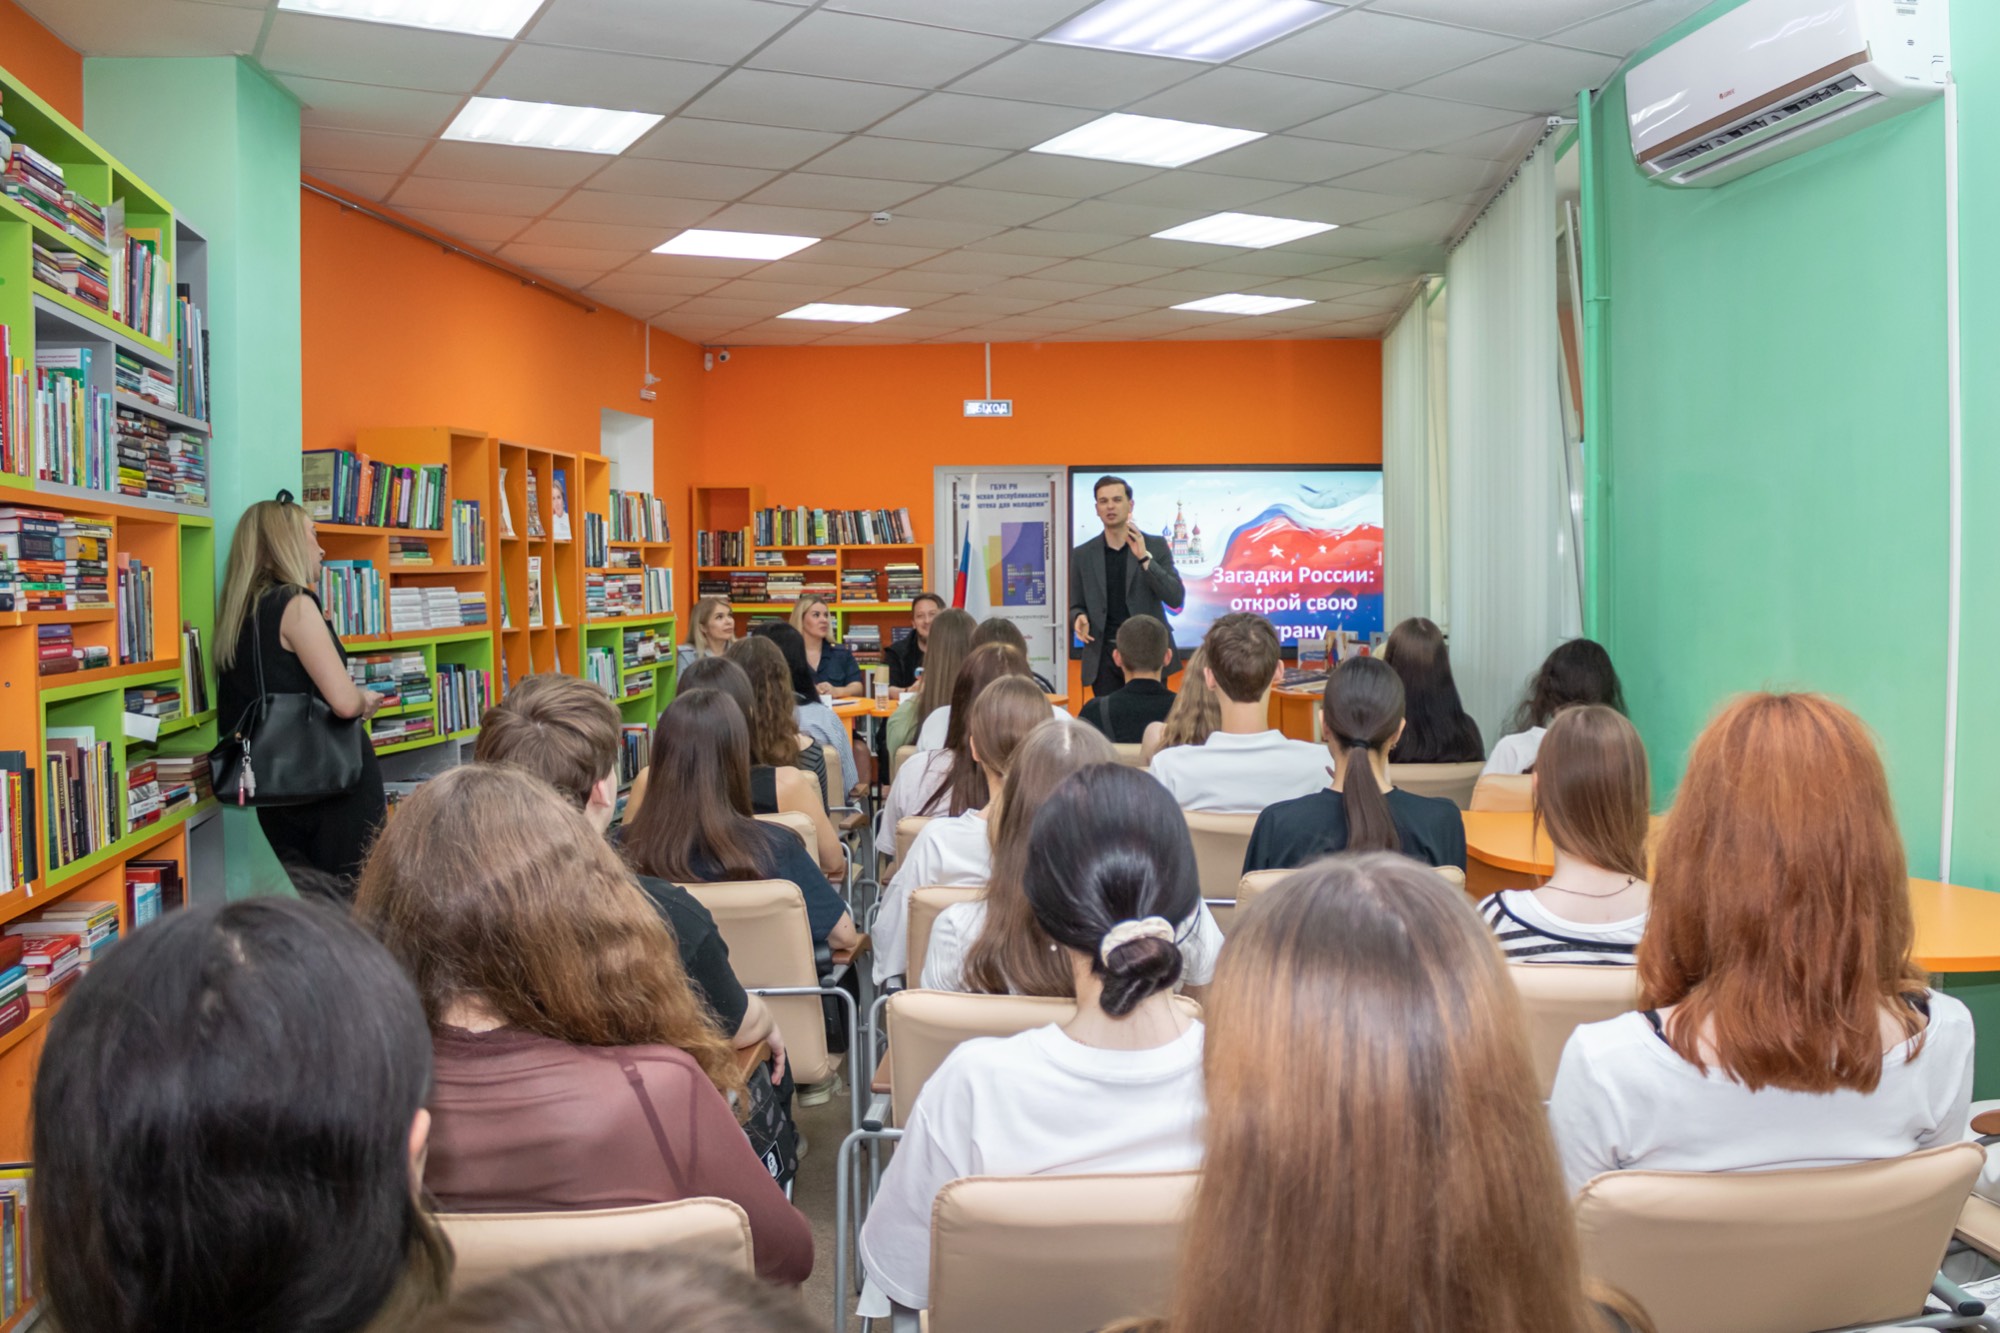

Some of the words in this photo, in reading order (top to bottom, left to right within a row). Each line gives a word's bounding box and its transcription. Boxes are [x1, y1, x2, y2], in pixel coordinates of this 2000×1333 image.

[1213, 567, 1293, 585] Загадки
[1298, 567, 1375, 583] России:
[1230, 594, 1301, 614] открой
[1306, 597, 1358, 611] свою
[1275, 625, 1328, 642] рану
